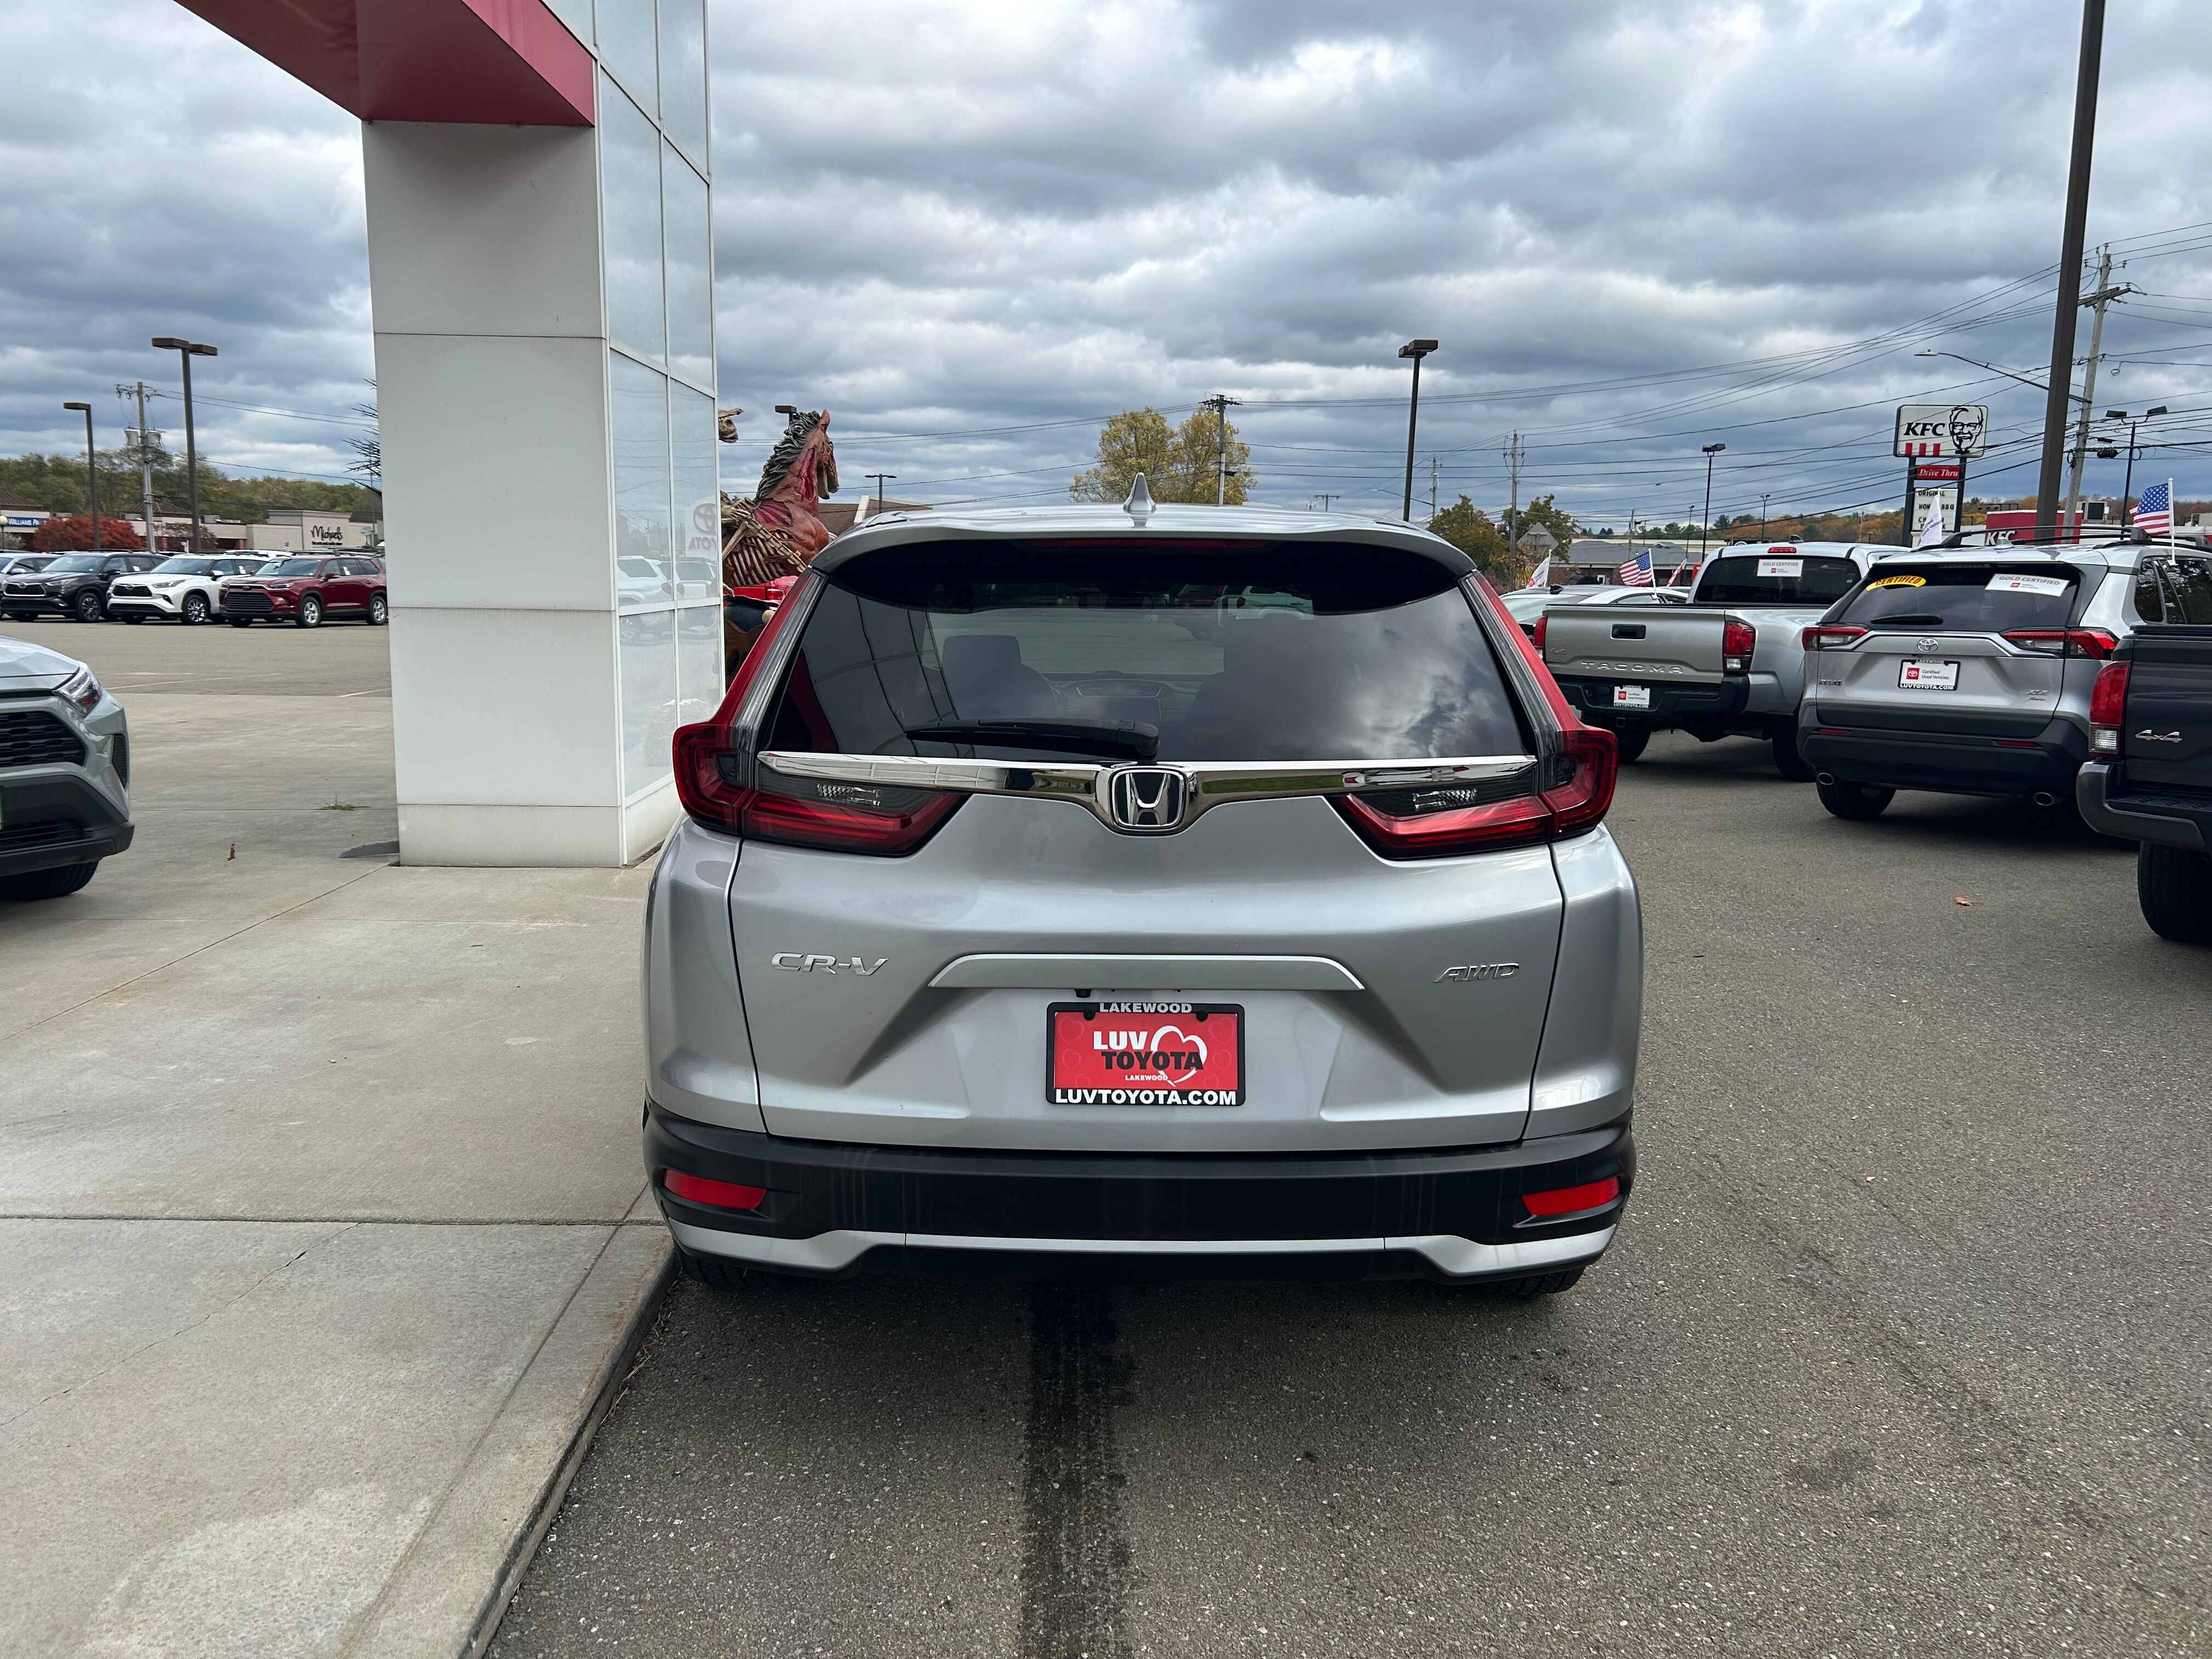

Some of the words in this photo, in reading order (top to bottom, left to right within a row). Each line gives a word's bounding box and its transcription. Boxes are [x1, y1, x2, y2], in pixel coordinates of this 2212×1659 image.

[1904, 422, 1946, 436] KFC
[1919, 469, 1939, 477] Drive
[1941, 469, 1959, 477] Thru
[310, 525, 343, 541] Michaels
[1985, 531, 2015, 545] KFC
[1875, 577, 1922, 586] CERTIFIED
[1581, 661, 1683, 674] TACOMA
[2135, 729, 2183, 743] 4x4
[771, 952, 889, 976] CR-V
[1433, 962, 1520, 983] AWD
[1099, 1002, 1192, 1013] LAKEWOOD
[1093, 1031, 1148, 1050] LUV
[1101, 1051, 1204, 1070] TOYOTA
[1056, 1088, 1236, 1105] LUVTOYOTA.COM
